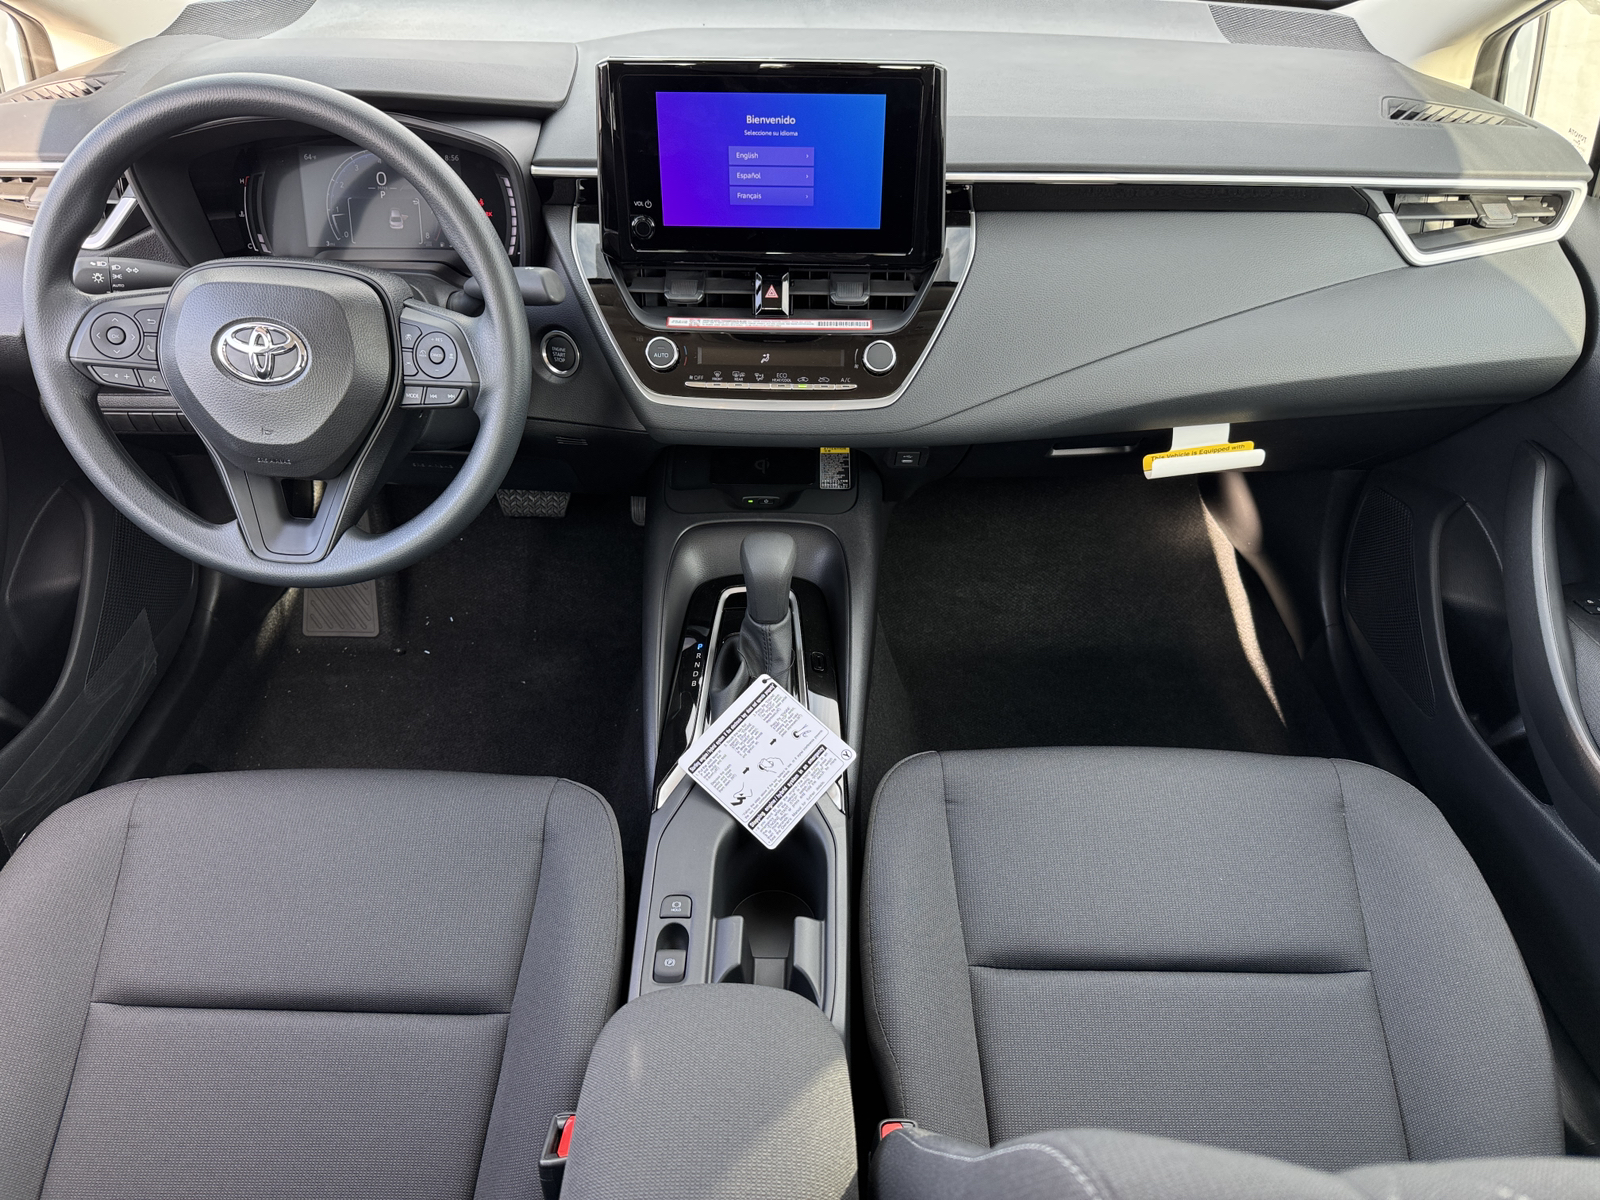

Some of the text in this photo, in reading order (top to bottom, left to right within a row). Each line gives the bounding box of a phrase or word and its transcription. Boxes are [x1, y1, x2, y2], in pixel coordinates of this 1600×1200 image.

[746, 115, 796, 125] Bienvenido
[736, 152, 758, 160] English
[376, 172, 387, 186] 0
[736, 172, 761, 180] Español
[737, 192, 762, 201] Français
[1199, 446, 1230, 454] Equipped
